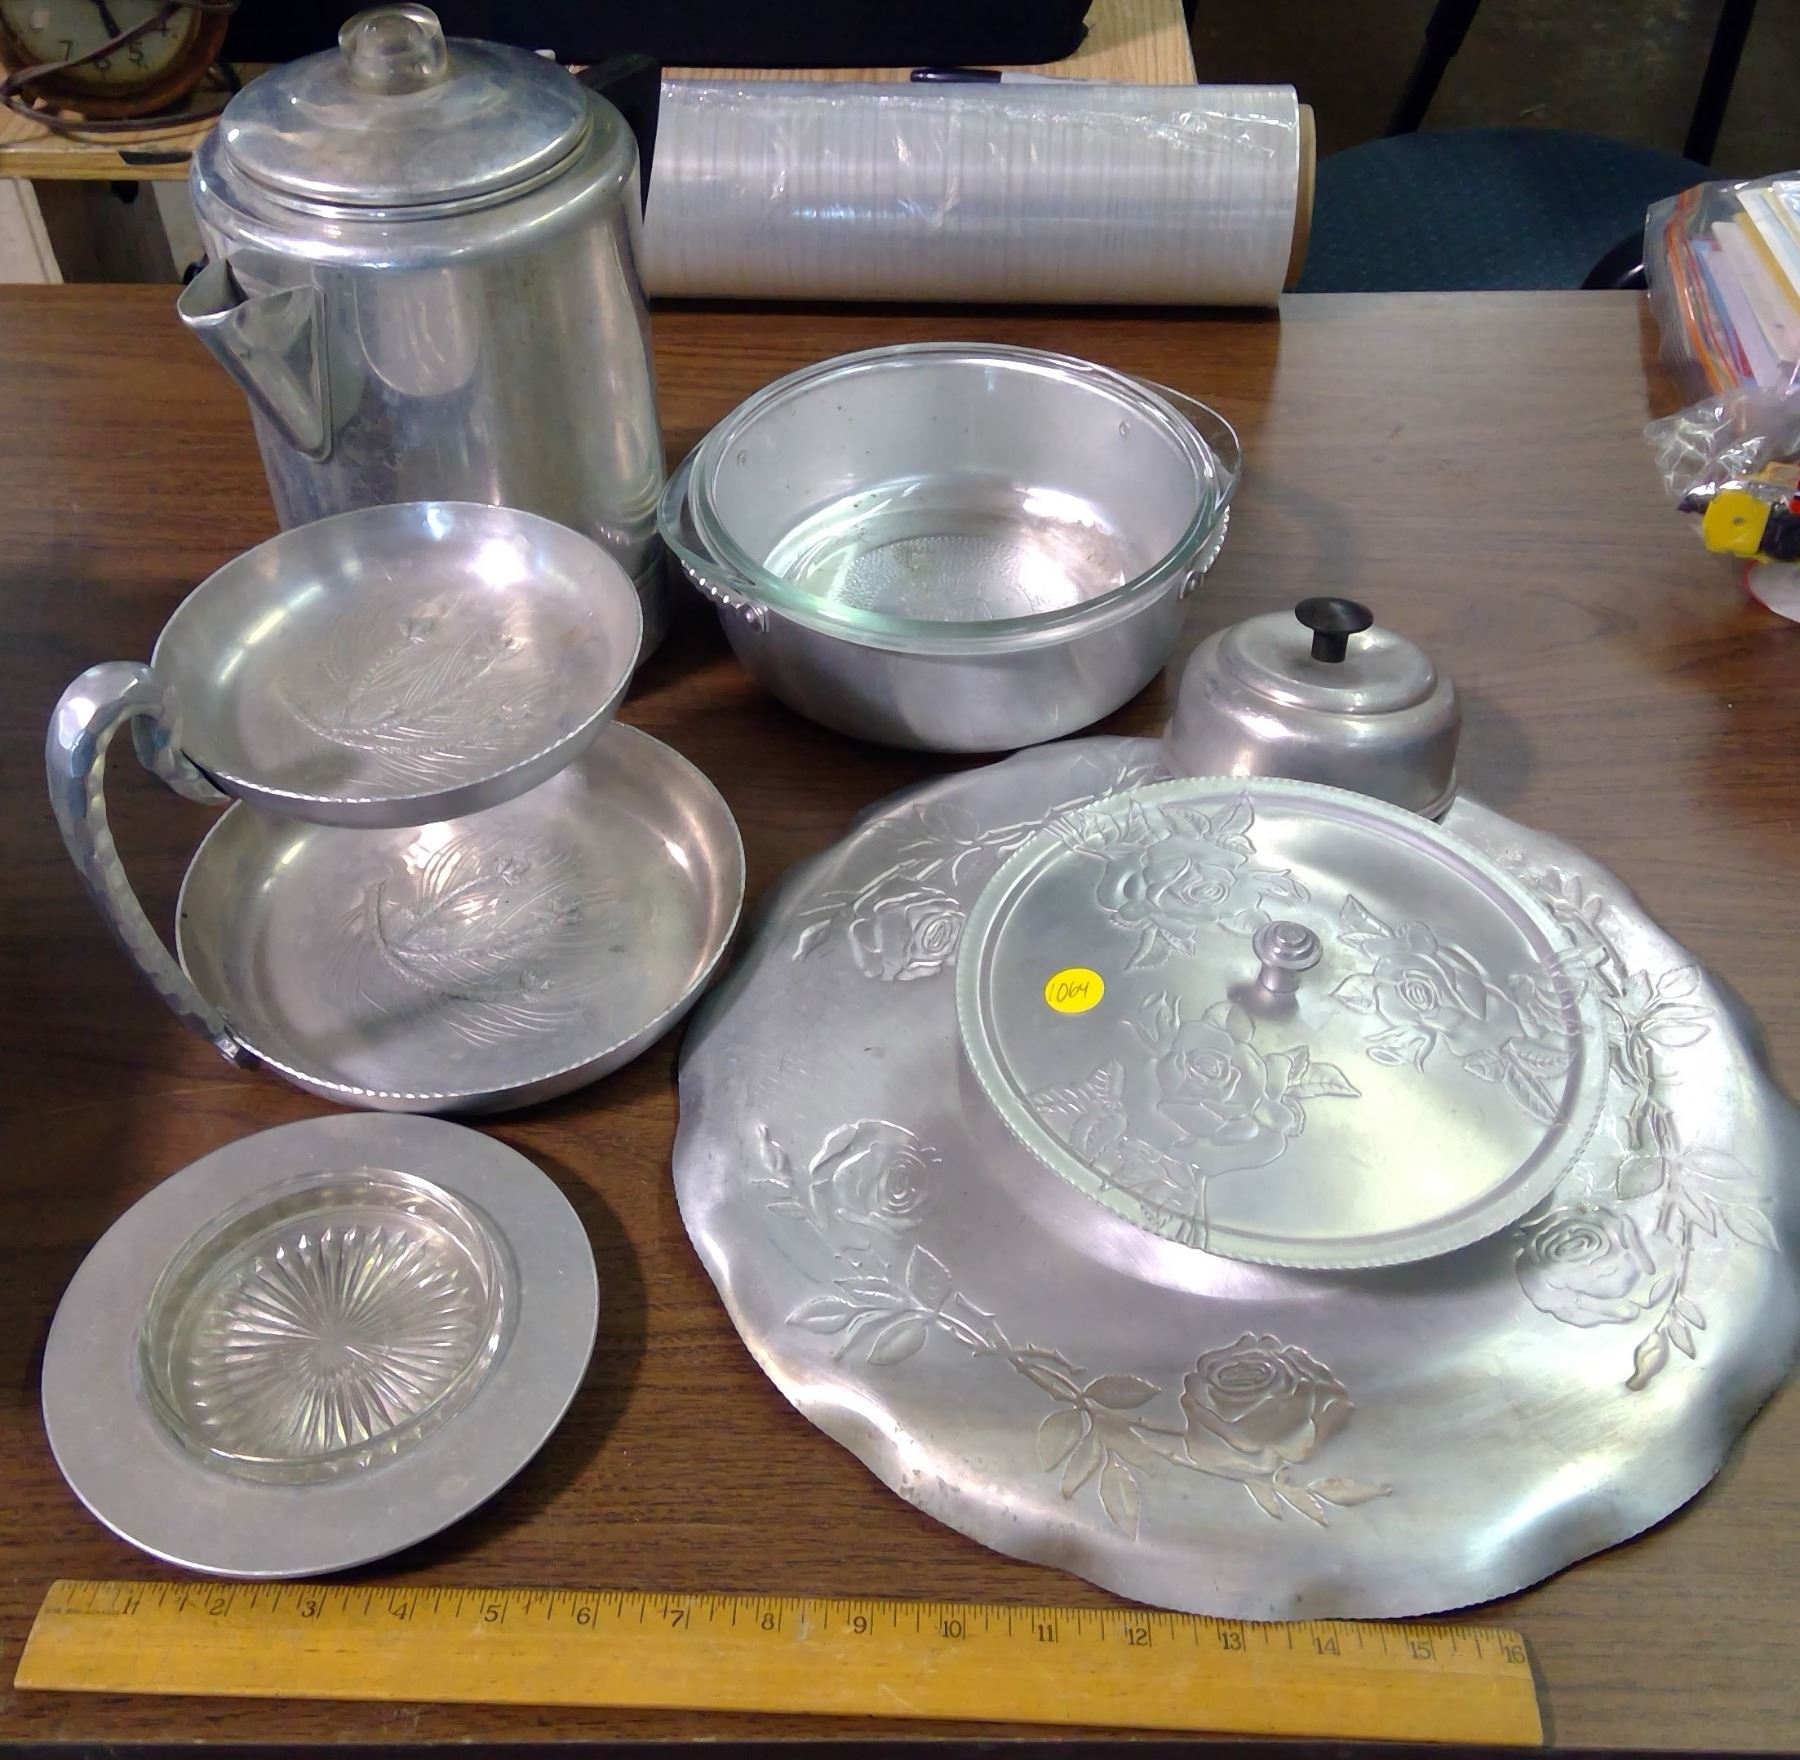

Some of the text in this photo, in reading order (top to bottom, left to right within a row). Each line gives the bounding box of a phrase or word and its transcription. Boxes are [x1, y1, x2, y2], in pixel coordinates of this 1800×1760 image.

[57, 40, 73, 62] 7
[1048, 980, 1090, 1003] 1064
[121, 1597, 133, 1615] 1
[209, 1598, 226, 1616] 2
[301, 1600, 317, 1618] 3
[392, 1602, 408, 1620] 4
[484, 1604, 502, 1622] 5
[576, 1607, 591, 1625] 6
[670, 1609, 685, 1628] 7
[761, 1612, 775, 1631] 8
[852, 1615, 868, 1634] 9
[941, 1620, 963, 1639] 10
[1036, 1624, 1055, 1642] 11
[1127, 1627, 1149, 1646] 12
[1220, 1631, 1243, 1650] 13
[1314, 1636, 1339, 1656] 14
[1409, 1641, 1432, 1660] 15
[1504, 1645, 1526, 1664] 16
